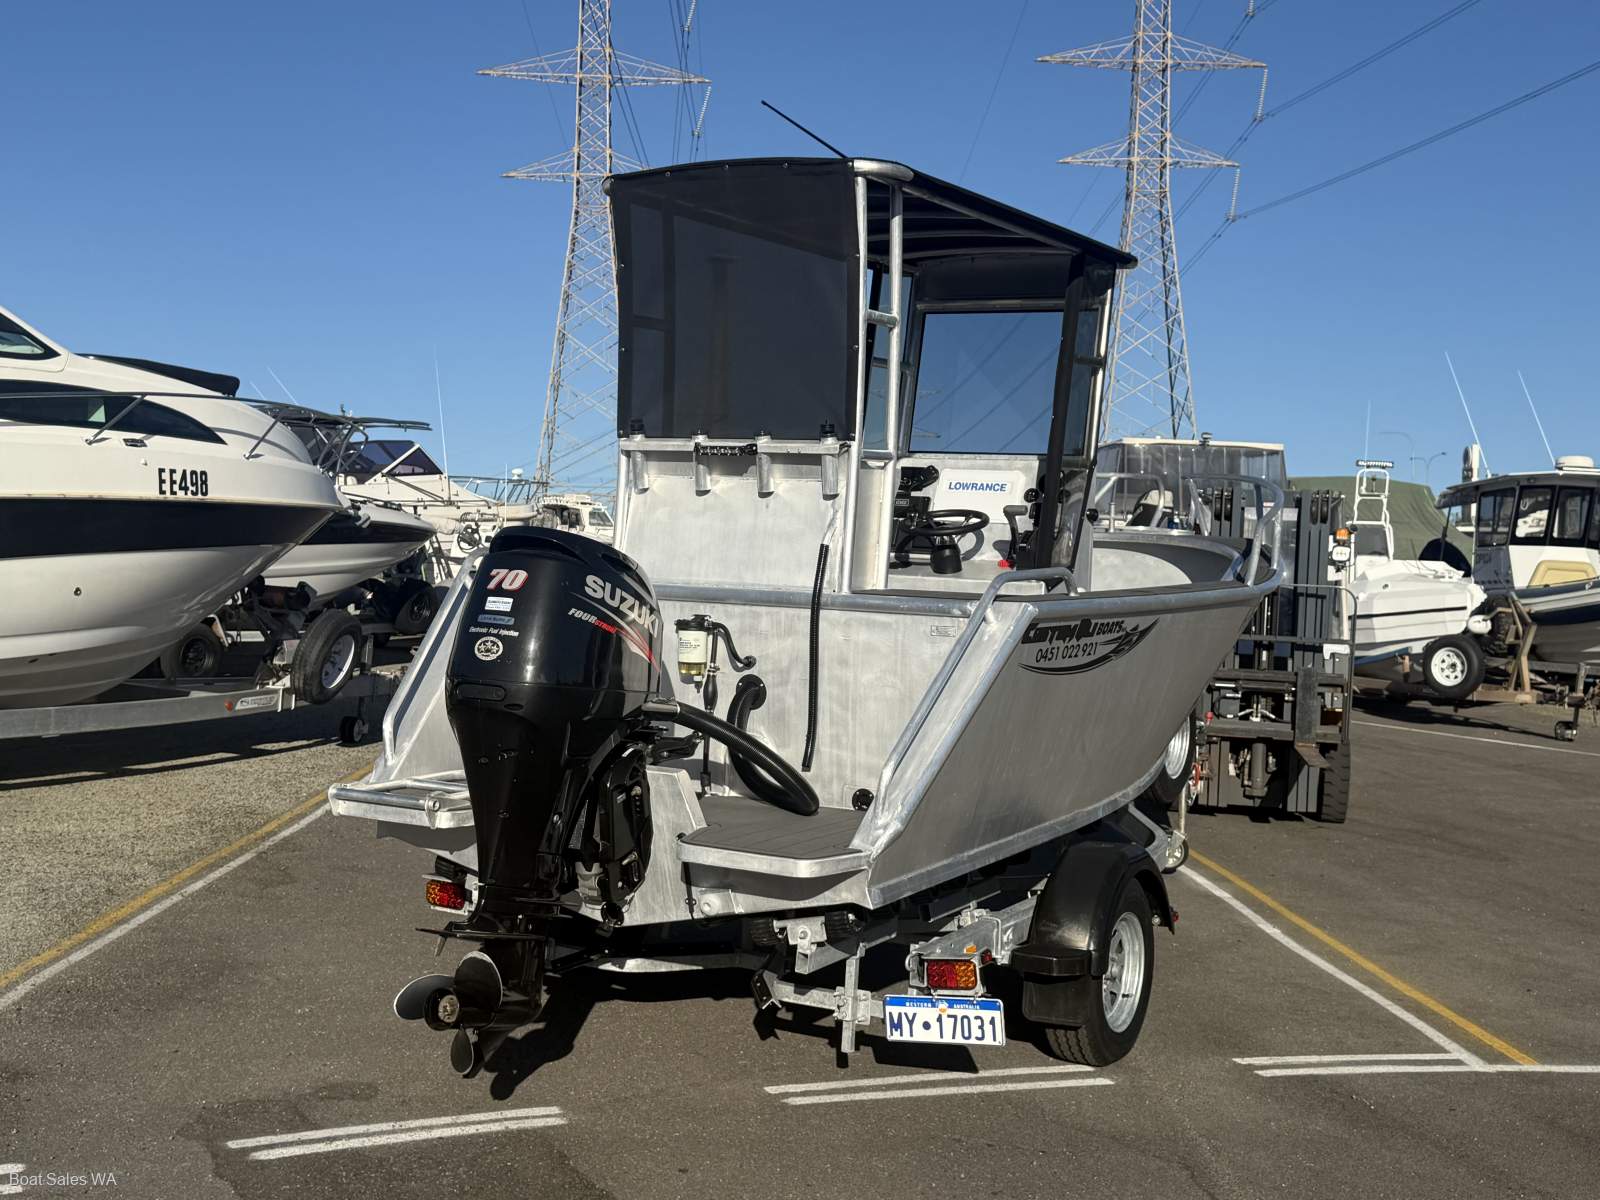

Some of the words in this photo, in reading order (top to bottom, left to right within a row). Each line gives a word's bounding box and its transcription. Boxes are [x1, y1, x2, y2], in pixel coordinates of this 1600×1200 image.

[158, 468, 208, 496] EE498
[948, 482, 1007, 492] LOWRANCE
[487, 568, 529, 592] 70
[584, 575, 659, 638] SUZUKI
[1035, 646, 1060, 663] 0451
